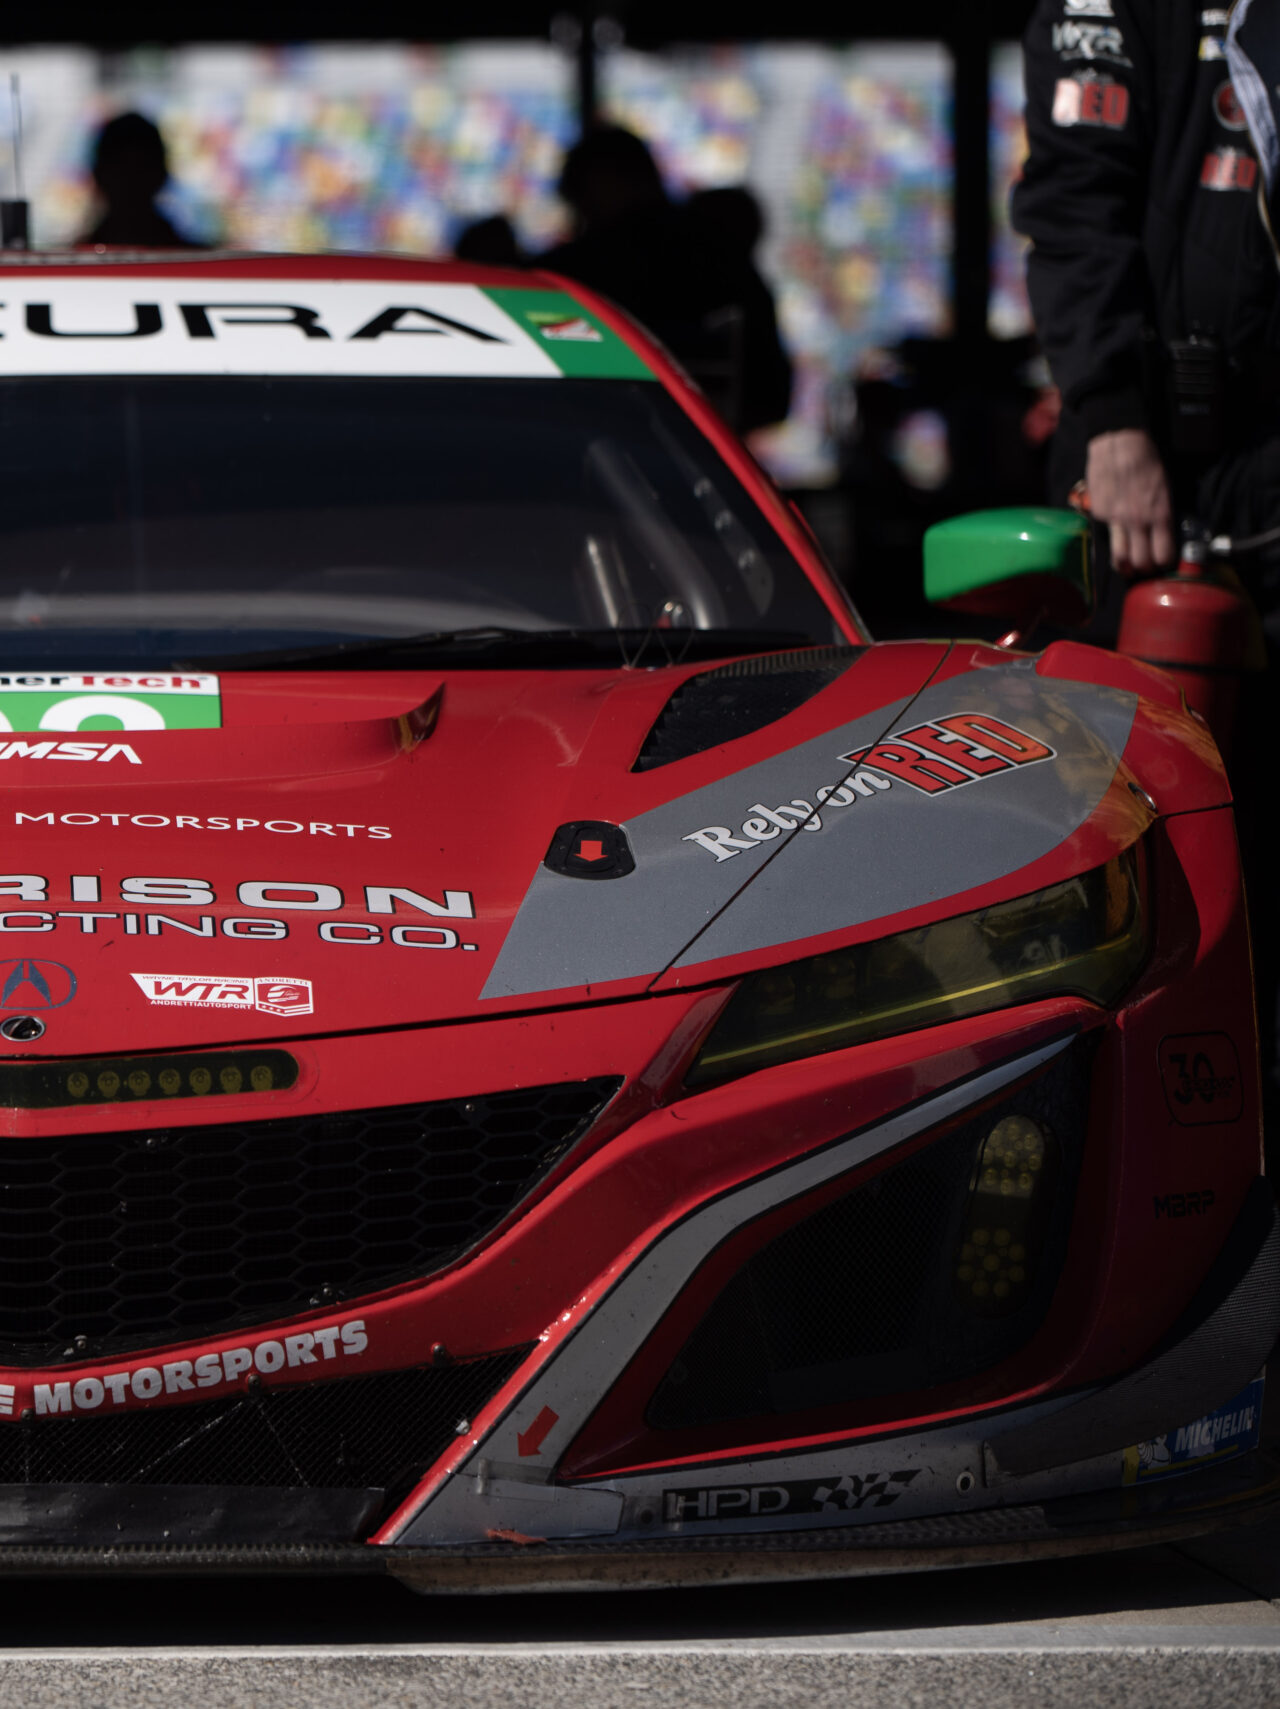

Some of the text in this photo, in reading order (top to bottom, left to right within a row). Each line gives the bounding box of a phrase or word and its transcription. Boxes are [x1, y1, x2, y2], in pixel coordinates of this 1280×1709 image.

[681, 711, 1058, 863] Rely on RED
[15, 812, 393, 840] MOTORSPORTS
[319, 922, 478, 951] CO.
[154, 981, 249, 1000] WTR
[1153, 1190, 1215, 1219] MBRP
[33, 1320, 370, 1415] MOTORSPORTS
[1175, 1406, 1256, 1452] MICHELIN
[666, 1486, 790, 1520] HPD
